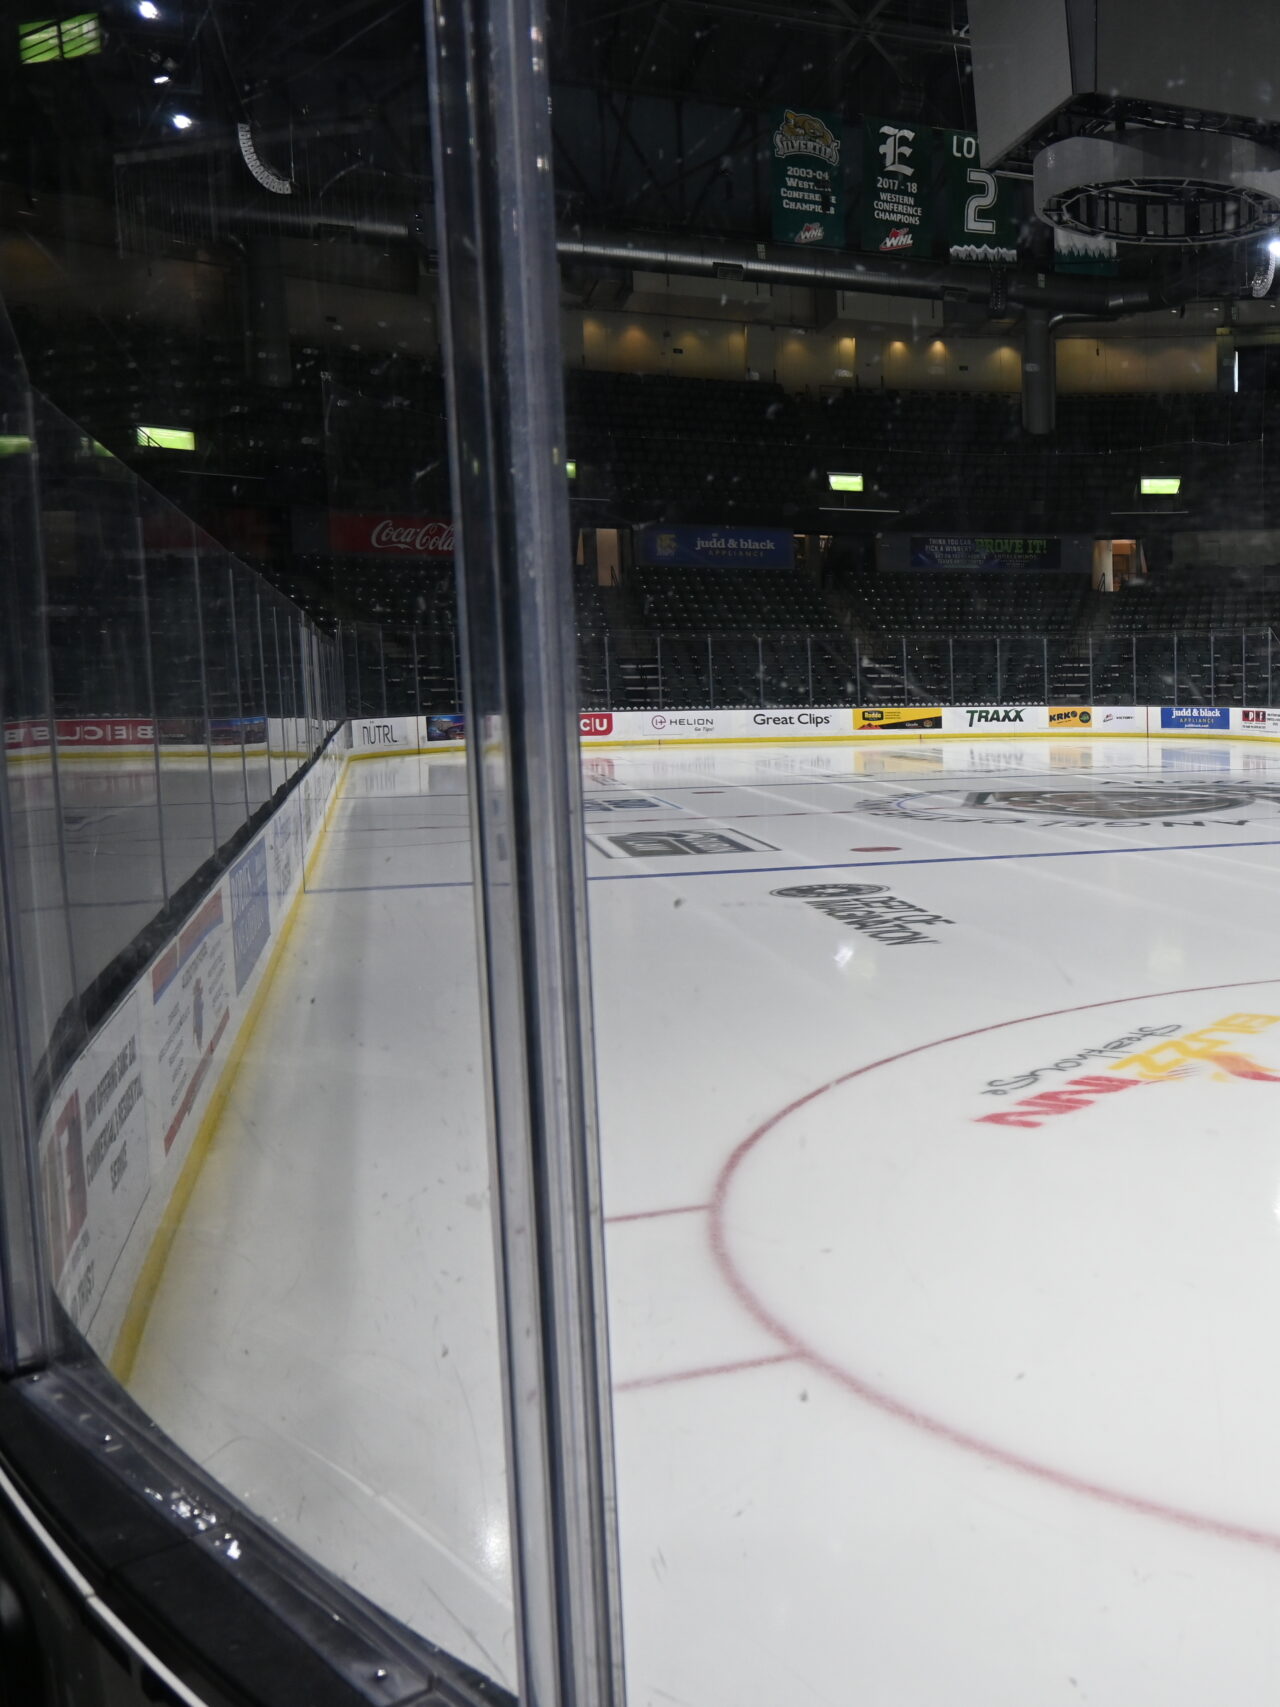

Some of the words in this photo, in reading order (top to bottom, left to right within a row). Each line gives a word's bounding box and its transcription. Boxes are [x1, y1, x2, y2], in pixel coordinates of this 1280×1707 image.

[786, 166, 829, 180] 2003-04
[785, 177, 831, 191] WEST
[877, 176, 898, 191] 2017
[906, 182, 917, 194] 18
[780, 188, 836, 204] CONFEREE
[879, 192, 914, 205] WESTERN
[782, 199, 835, 214] CHAMPIS
[873, 201, 922, 216] CONFERENCE
[874, 210, 920, 225] CHAMPIONS
[885, 233, 913, 247] WHL
[695, 537, 726, 551] judd
[727, 538, 738, 549] &
[740, 538, 775, 550] black
[975, 538, 1024, 554] PROVE
[1026, 539, 1048, 555] IT!
[966, 708, 1027, 727] TRAXX
[1172, 708, 1191, 718] judd
[1192, 708, 1199, 717] &
[1199, 709, 1221, 717] black
[580, 718, 607, 731] CU
[669, 718, 714, 726] HELION
[753, 713, 795, 726] Great
[797, 713, 831, 728] Clips
